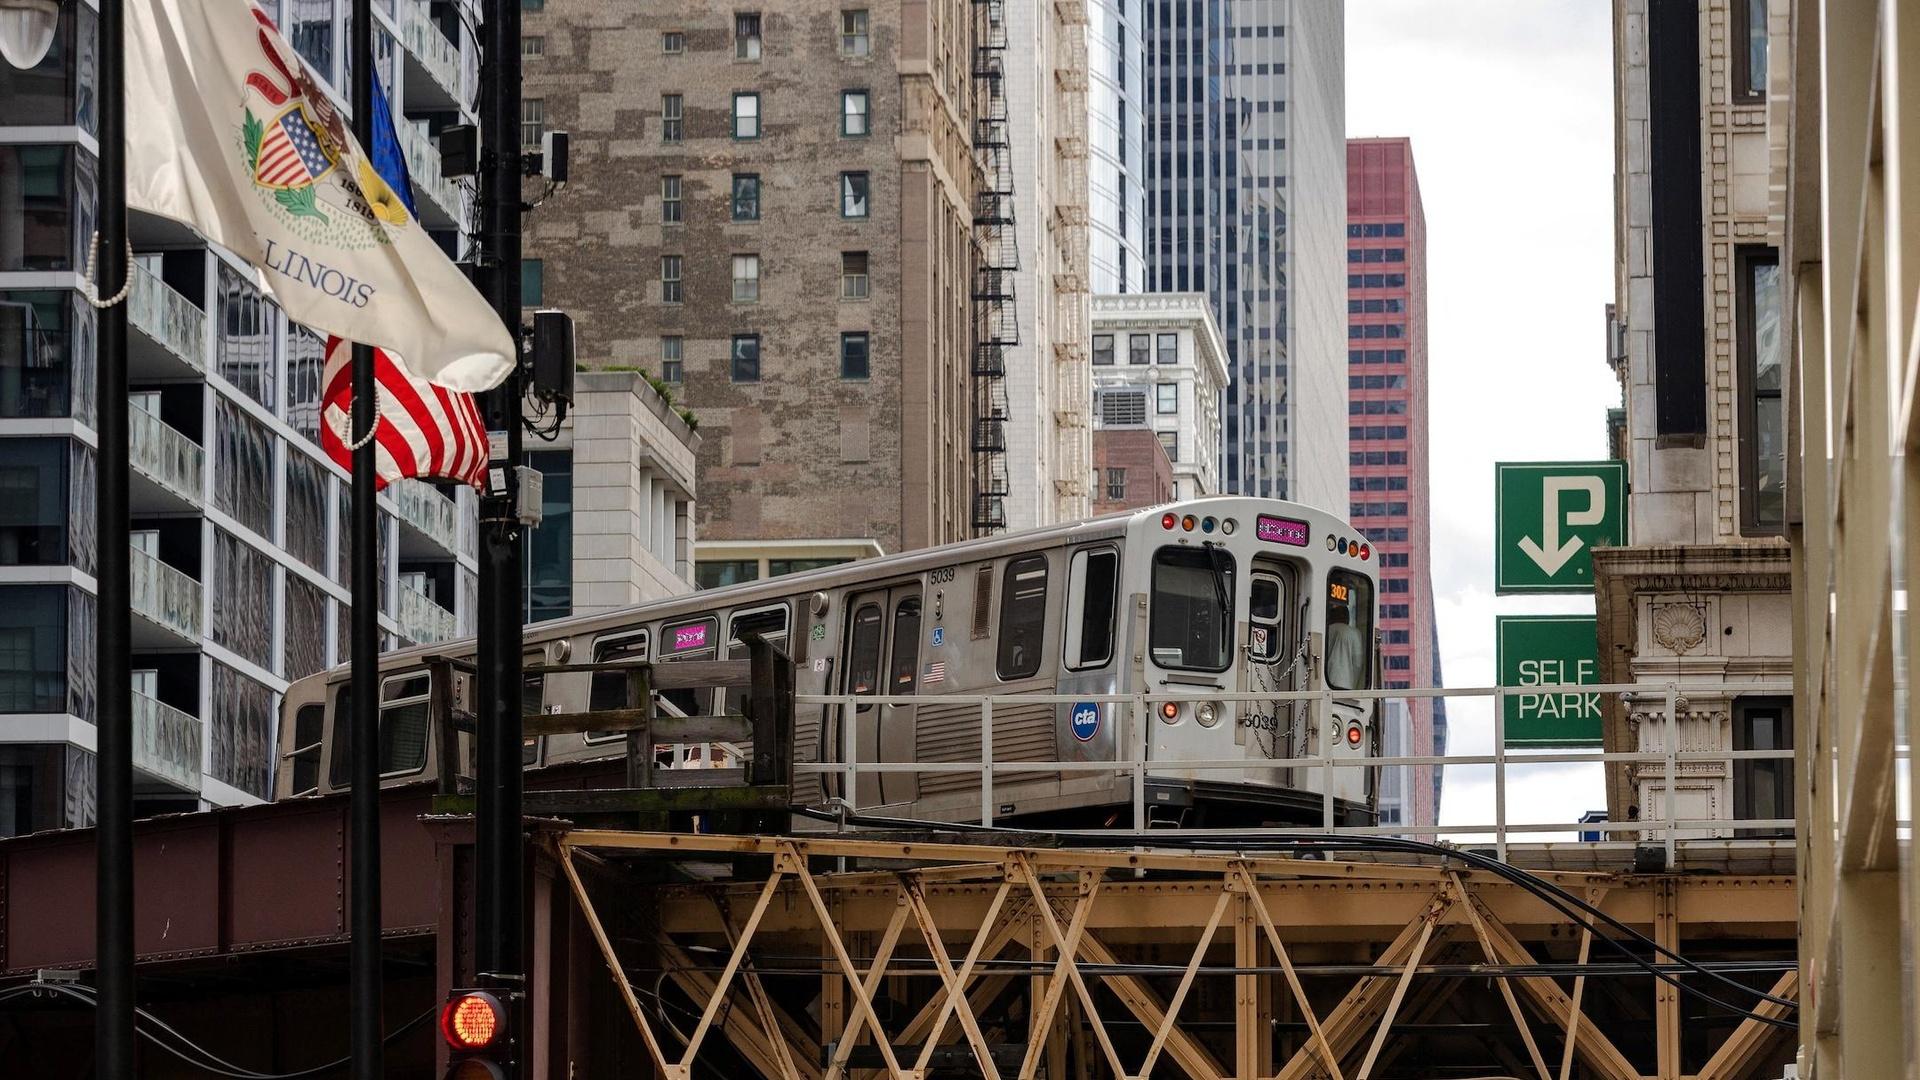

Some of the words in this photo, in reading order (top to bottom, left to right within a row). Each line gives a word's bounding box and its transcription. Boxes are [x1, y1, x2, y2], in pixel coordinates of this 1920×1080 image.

[264, 238, 376, 309] LINOIS
[931, 567, 955, 585] 5039
[1331, 583, 1347, 601] 302
[1518, 659, 1594, 687] SELF
[1518, 692, 1602, 719] PARK
[1075, 709, 1096, 726] cta
